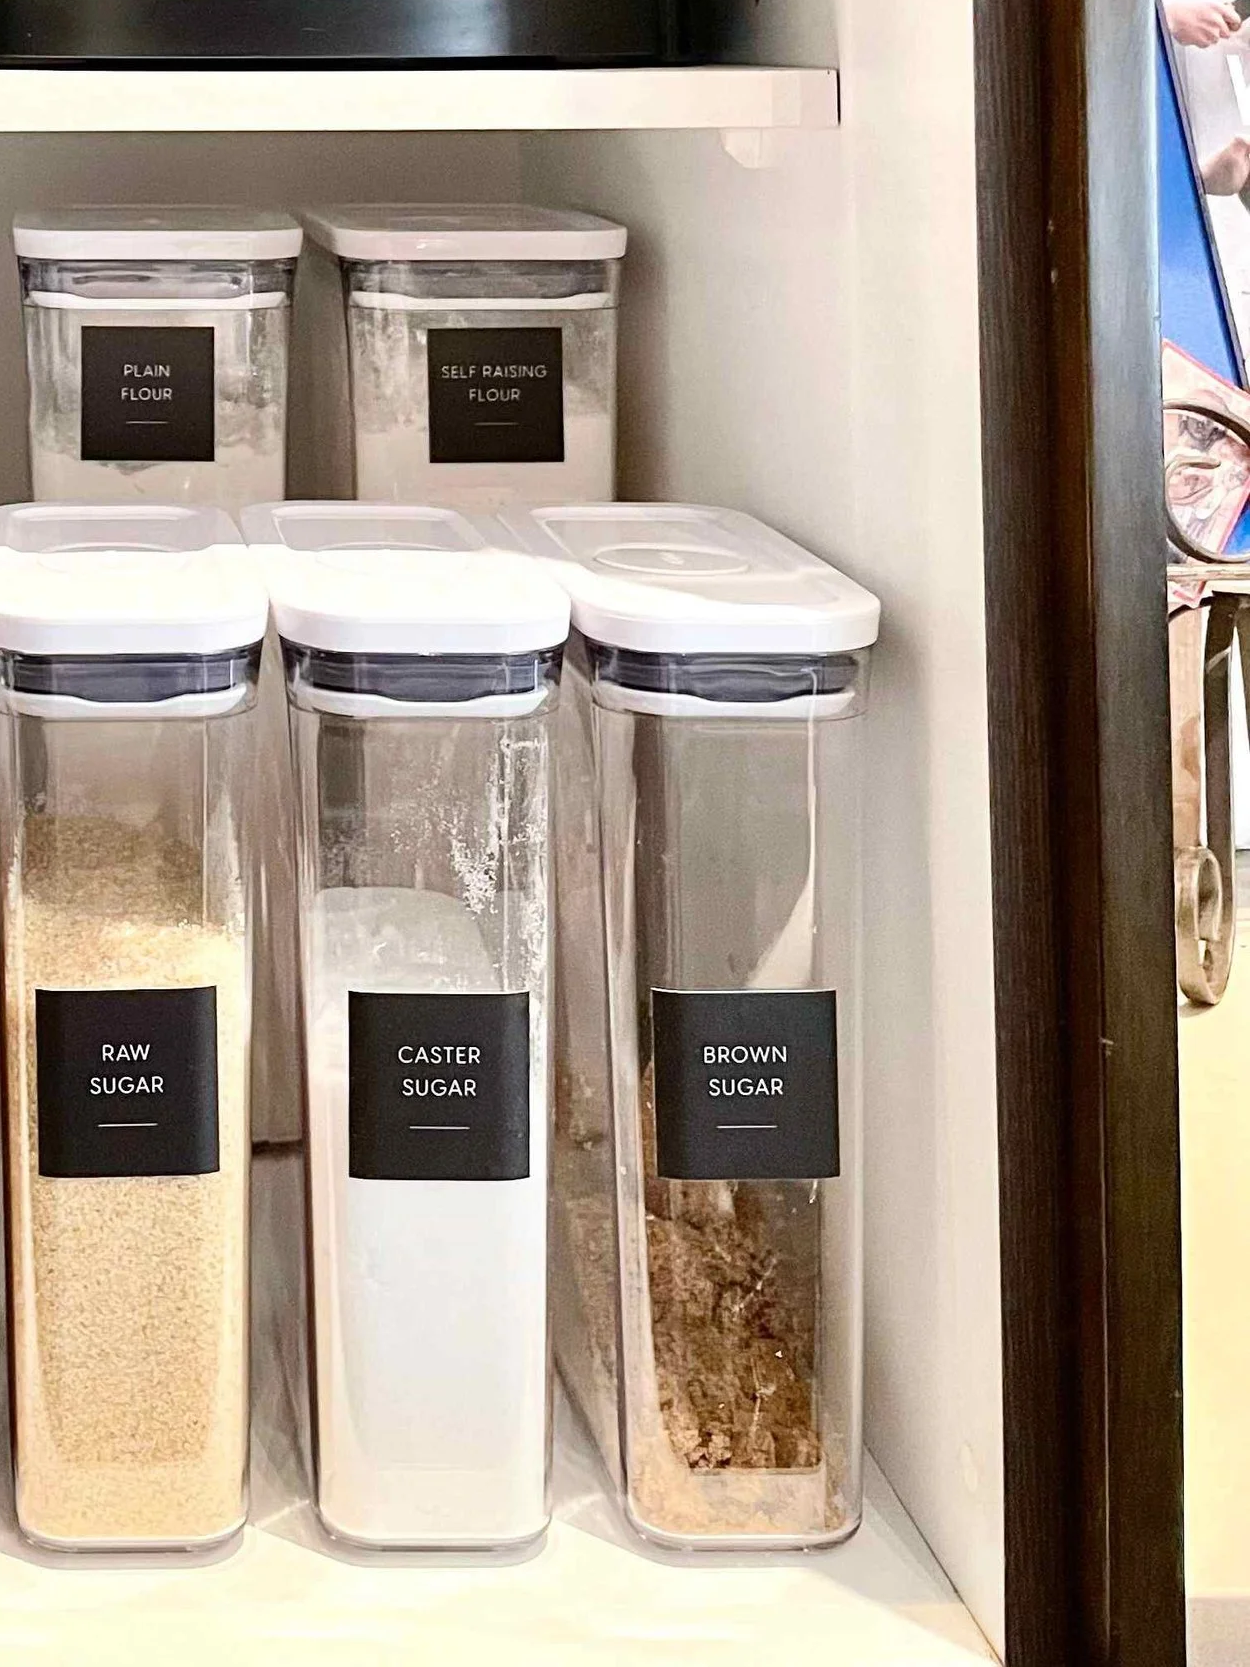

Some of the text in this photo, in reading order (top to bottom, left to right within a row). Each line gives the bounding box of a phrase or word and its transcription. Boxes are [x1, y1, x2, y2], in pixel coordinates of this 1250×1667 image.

[123, 364, 171, 378] PLAIN
[441, 365, 548, 379] SELF RAISING
[121, 387, 174, 401] FLOUR
[468, 387, 521, 402] FLOUR
[102, 1043, 152, 1062] RAW
[398, 1045, 481, 1065] CASTER
[703, 1045, 787, 1064] BROWN
[90, 1075, 165, 1095] SUGAR
[402, 1078, 477, 1097] SUGAR
[708, 1077, 784, 1097] SUGAR
